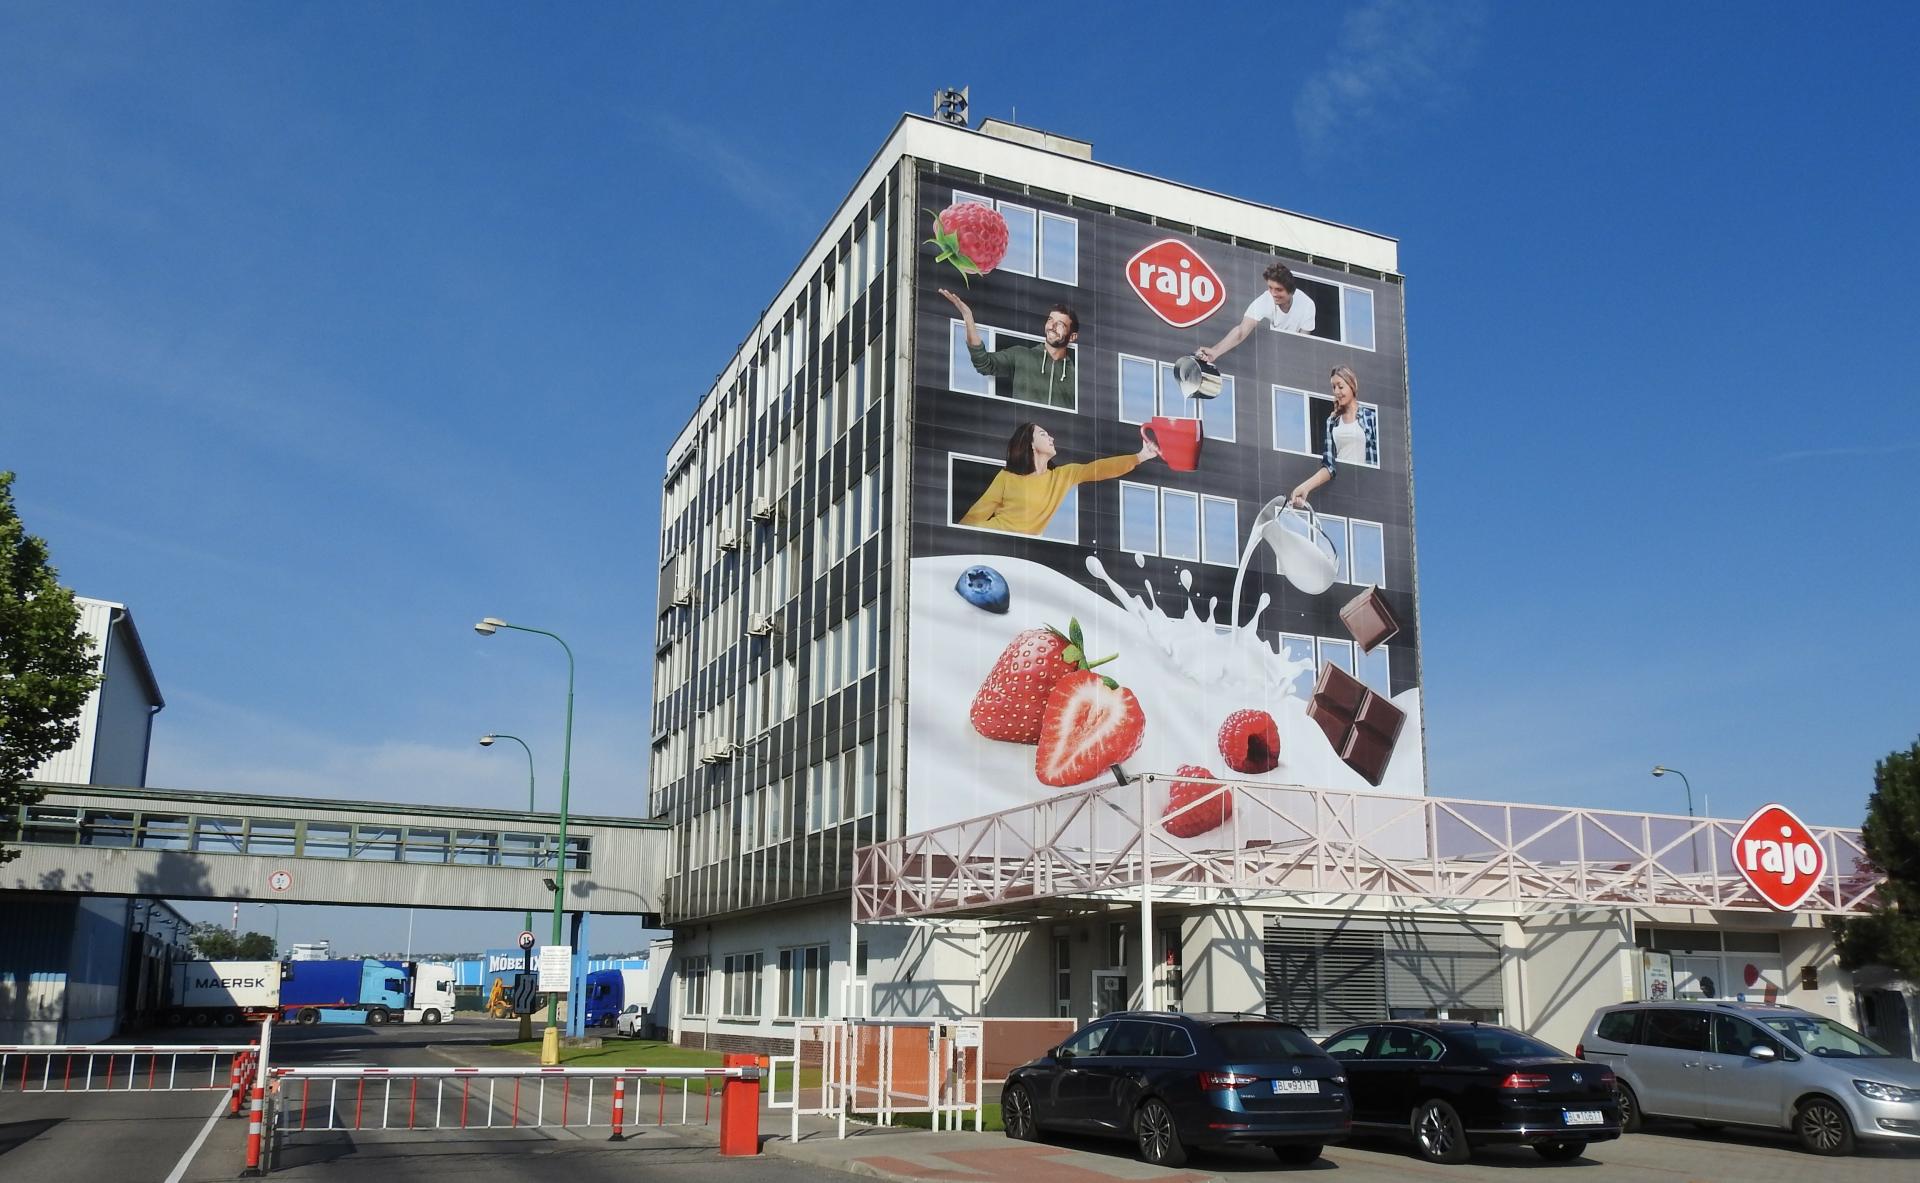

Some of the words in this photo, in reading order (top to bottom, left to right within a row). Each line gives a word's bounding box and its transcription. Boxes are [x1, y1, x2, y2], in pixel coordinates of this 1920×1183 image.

[1139, 258, 1215, 306] rajo
[1744, 825, 1818, 885] rajo
[489, 953, 541, 973] MÖBEIX
[195, 978, 264, 988] MAERSK
